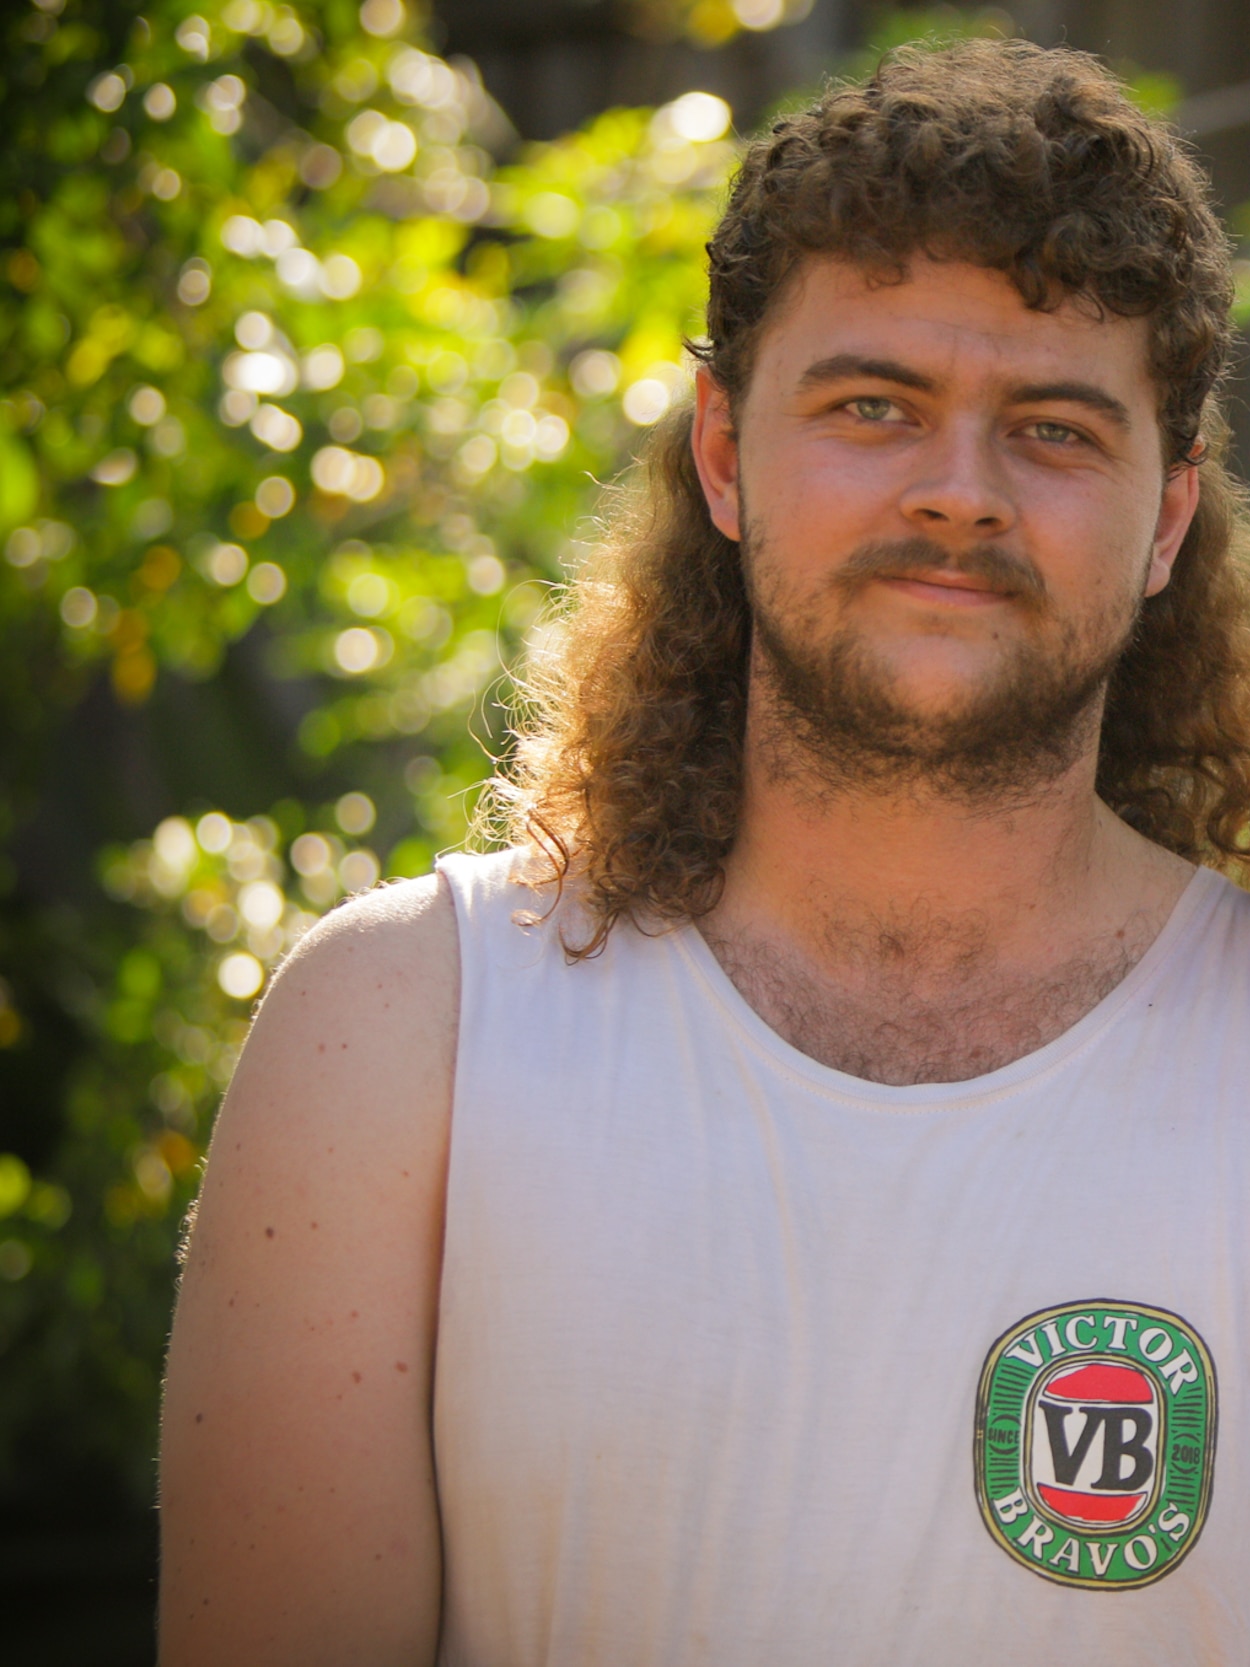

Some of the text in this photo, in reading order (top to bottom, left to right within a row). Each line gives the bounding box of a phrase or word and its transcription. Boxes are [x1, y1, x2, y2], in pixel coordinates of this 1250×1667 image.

[1004, 1315, 1199, 1396] VICTOR
[988, 1428, 1020, 1444] SINCE
[1038, 1400, 1154, 1491] VB
[1171, 1444, 1200, 1464] 2018
[992, 1486, 1190, 1576] BRAVO'S
